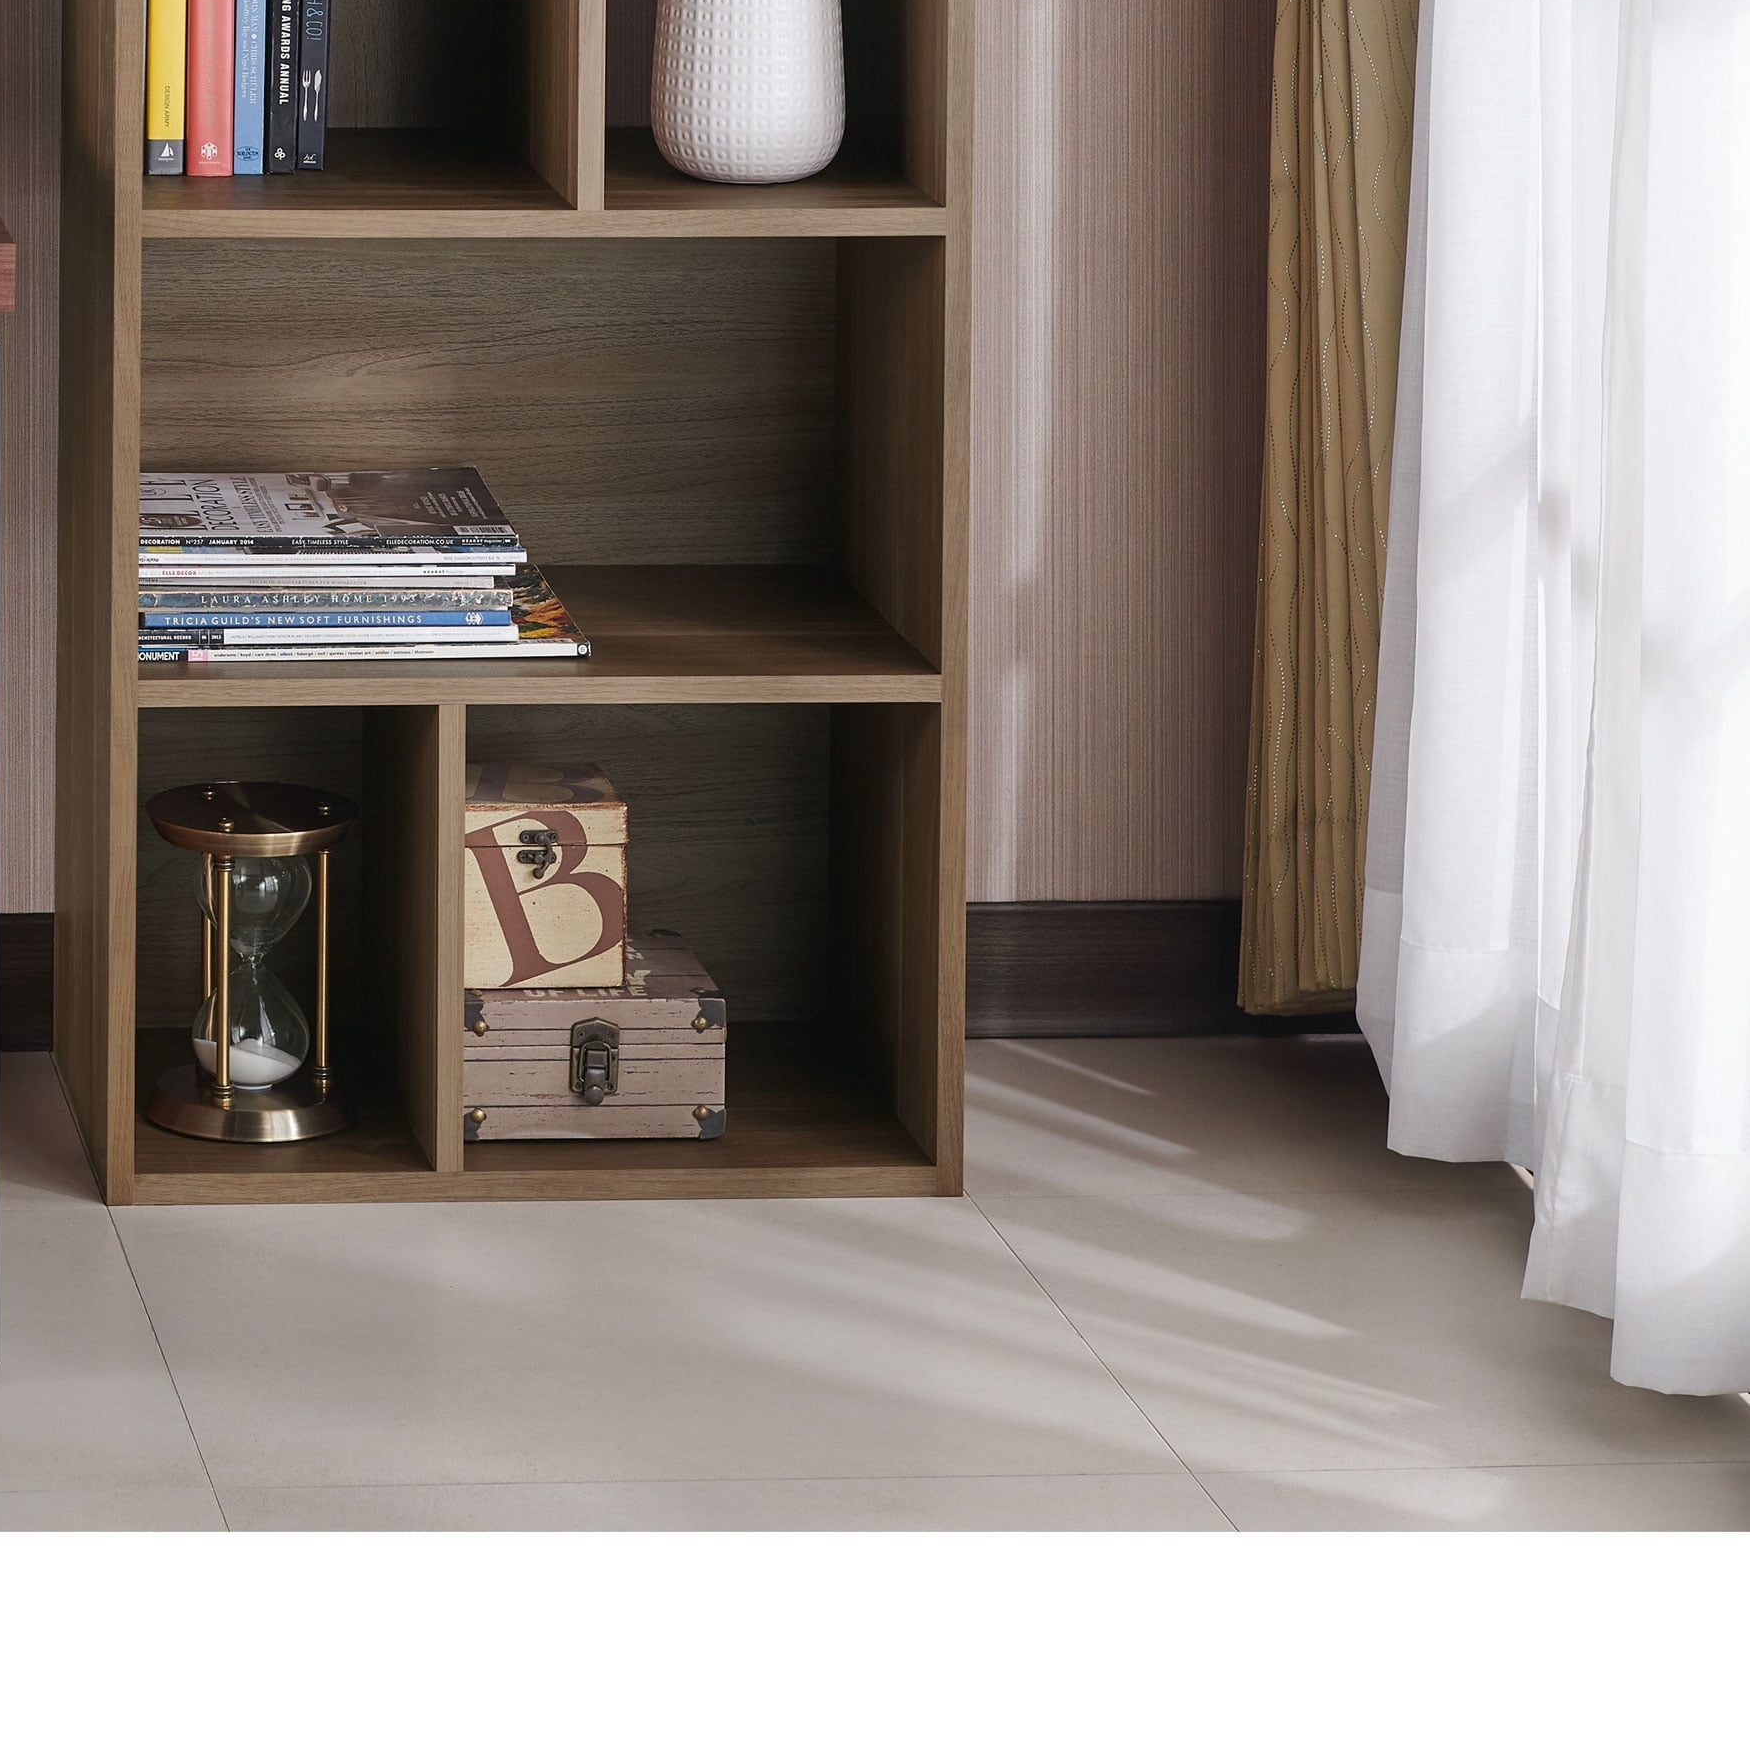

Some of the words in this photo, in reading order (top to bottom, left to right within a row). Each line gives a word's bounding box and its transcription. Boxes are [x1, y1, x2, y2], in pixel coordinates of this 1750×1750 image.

[306, 7, 323, 18] &
[280, 15, 291, 59] AWARDS
[306, 21, 323, 41] CO!
[250, 41, 258, 65] CHRIS
[279, 63, 290, 105] ANNUAL
[188, 479, 240, 531] DECORATION
[200, 594, 251, 604] LAURA
[261, 594, 321, 604] ASHLEY
[331, 594, 373, 603] HOME
[165, 616, 207, 625] TRICIA
[211, 616, 261, 625] GUILD'S
[267, 616, 295, 625] NEW
[300, 616, 330, 625] SOFT
[337, 615, 423, 624] FURNISHINGS
[138, 651, 180, 661] ONUMENT
[465, 810, 625, 987] B
